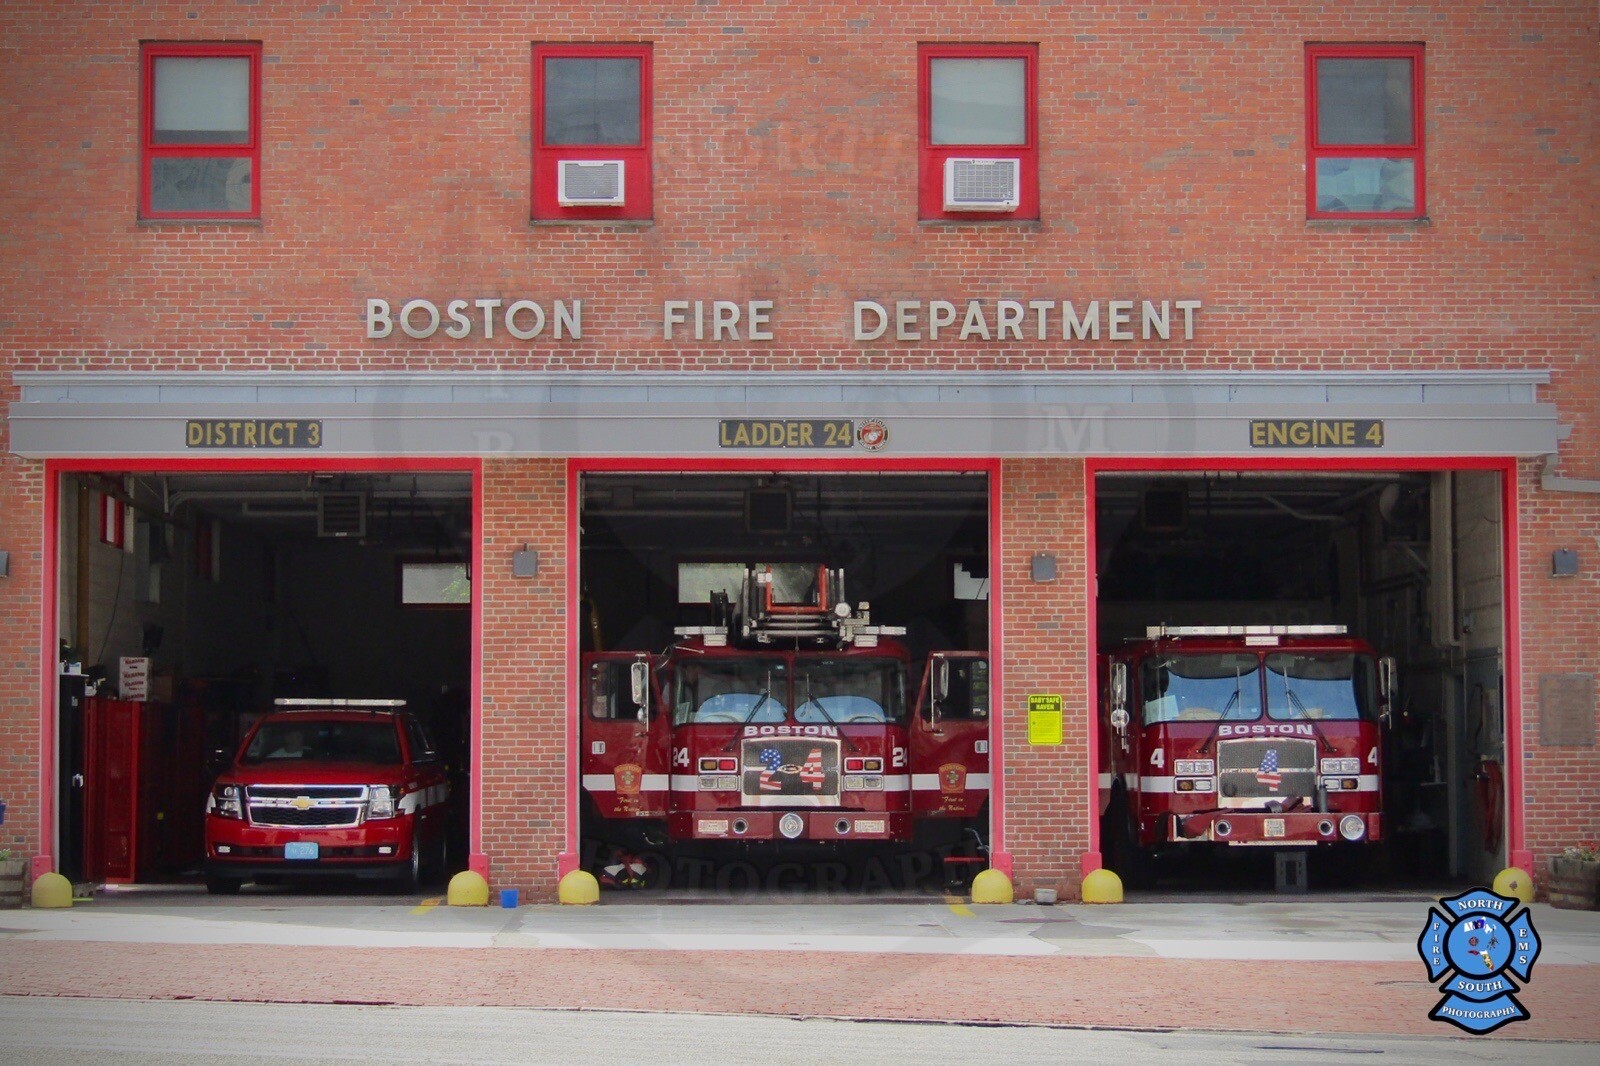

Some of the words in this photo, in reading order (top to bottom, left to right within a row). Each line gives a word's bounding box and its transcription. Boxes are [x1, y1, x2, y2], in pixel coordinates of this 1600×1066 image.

[366, 298, 583, 340] BOSTON
[664, 299, 775, 341] FIRE
[854, 299, 1203, 341] DEPARTMENT
[188, 422, 298, 446] DISTRICT
[308, 422, 321, 446] 3
[721, 422, 814, 446] LADDER
[824, 423, 851, 445] 24
[1252, 423, 1355, 445] ENGINE
[1366, 423, 1382, 445] 4
[743, 724, 839, 738] BOSTON
[1218, 724, 1313, 736] BOSTON
[672, 746, 690, 768] 24
[1150, 748, 1165, 768] 4
[1256, 748, 1282, 792] 4
